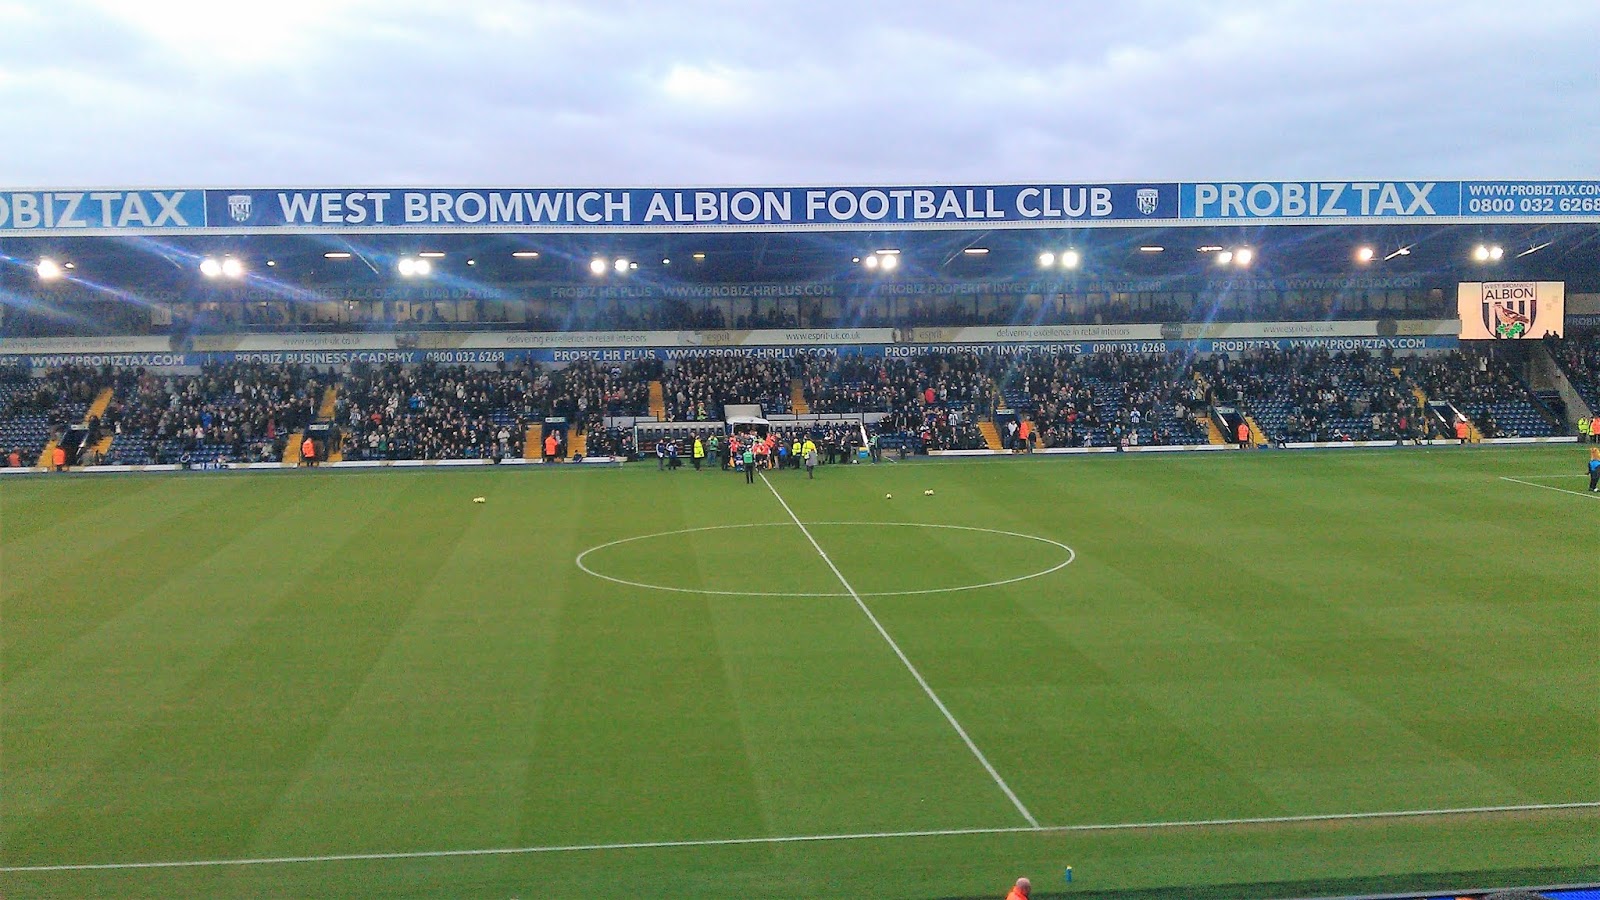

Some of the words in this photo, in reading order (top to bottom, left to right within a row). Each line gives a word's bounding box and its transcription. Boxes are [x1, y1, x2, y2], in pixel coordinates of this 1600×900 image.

[278, 192, 390, 223] WEST
[404, 191, 631, 223] BROMWICH
[644, 191, 791, 222] ALBION
[806, 189, 1004, 220] FOOTBALL
[1016, 187, 1113, 217] CLUB
[1194, 182, 1347, 217] PROBIZ
[1352, 182, 1436, 216] TAX
[1469, 198, 1514, 212] 0800
[1520, 198, 1554, 212] 032
[1560, 197, 1600, 212] 6268
[0, 193, 87, 228] BIZ
[91, 191, 189, 227] TAX
[551, 287, 597, 298] PROBIZ
[600, 286, 618, 297] HR
[621, 286, 652, 297] PLUS
[663, 285, 834, 297] WWW.PROBIZ-HRPLUS.COM
[1484, 287, 1534, 300] ALBION
[786, 330, 861, 341] www.esprit-uk.co.uk
[996, 328, 1032, 338] delivering
[1033, 327, 1071, 337] excellence
[1081, 326, 1100, 336] retail
[1101, 326, 1130, 336] interiors
[884, 346, 928, 357] PROBIZ
[1121, 343, 1139, 353] 032
[1141, 342, 1166, 353] 6268
[1212, 341, 1255, 352] PROBIZ
[1289, 338, 1426, 350] WWW.PROBIZTAX.COM
[29, 354, 185, 368] WWW.PROBIZTAX.COM
[235, 353, 282, 364] PROBIZ
[287, 352, 348, 364] BUSINESS
[349, 352, 414, 363] ACADEMY
[426, 351, 453, 362] 0800
[456, 351, 475, 362] 032
[479, 351, 505, 362] 6268
[554, 350, 600, 361] PROBIZ
[603, 350, 621, 361] HR
[624, 349, 656, 360] PLUS
[665, 347, 838, 359] WWWPROBIZ-HRPLUSCOM
